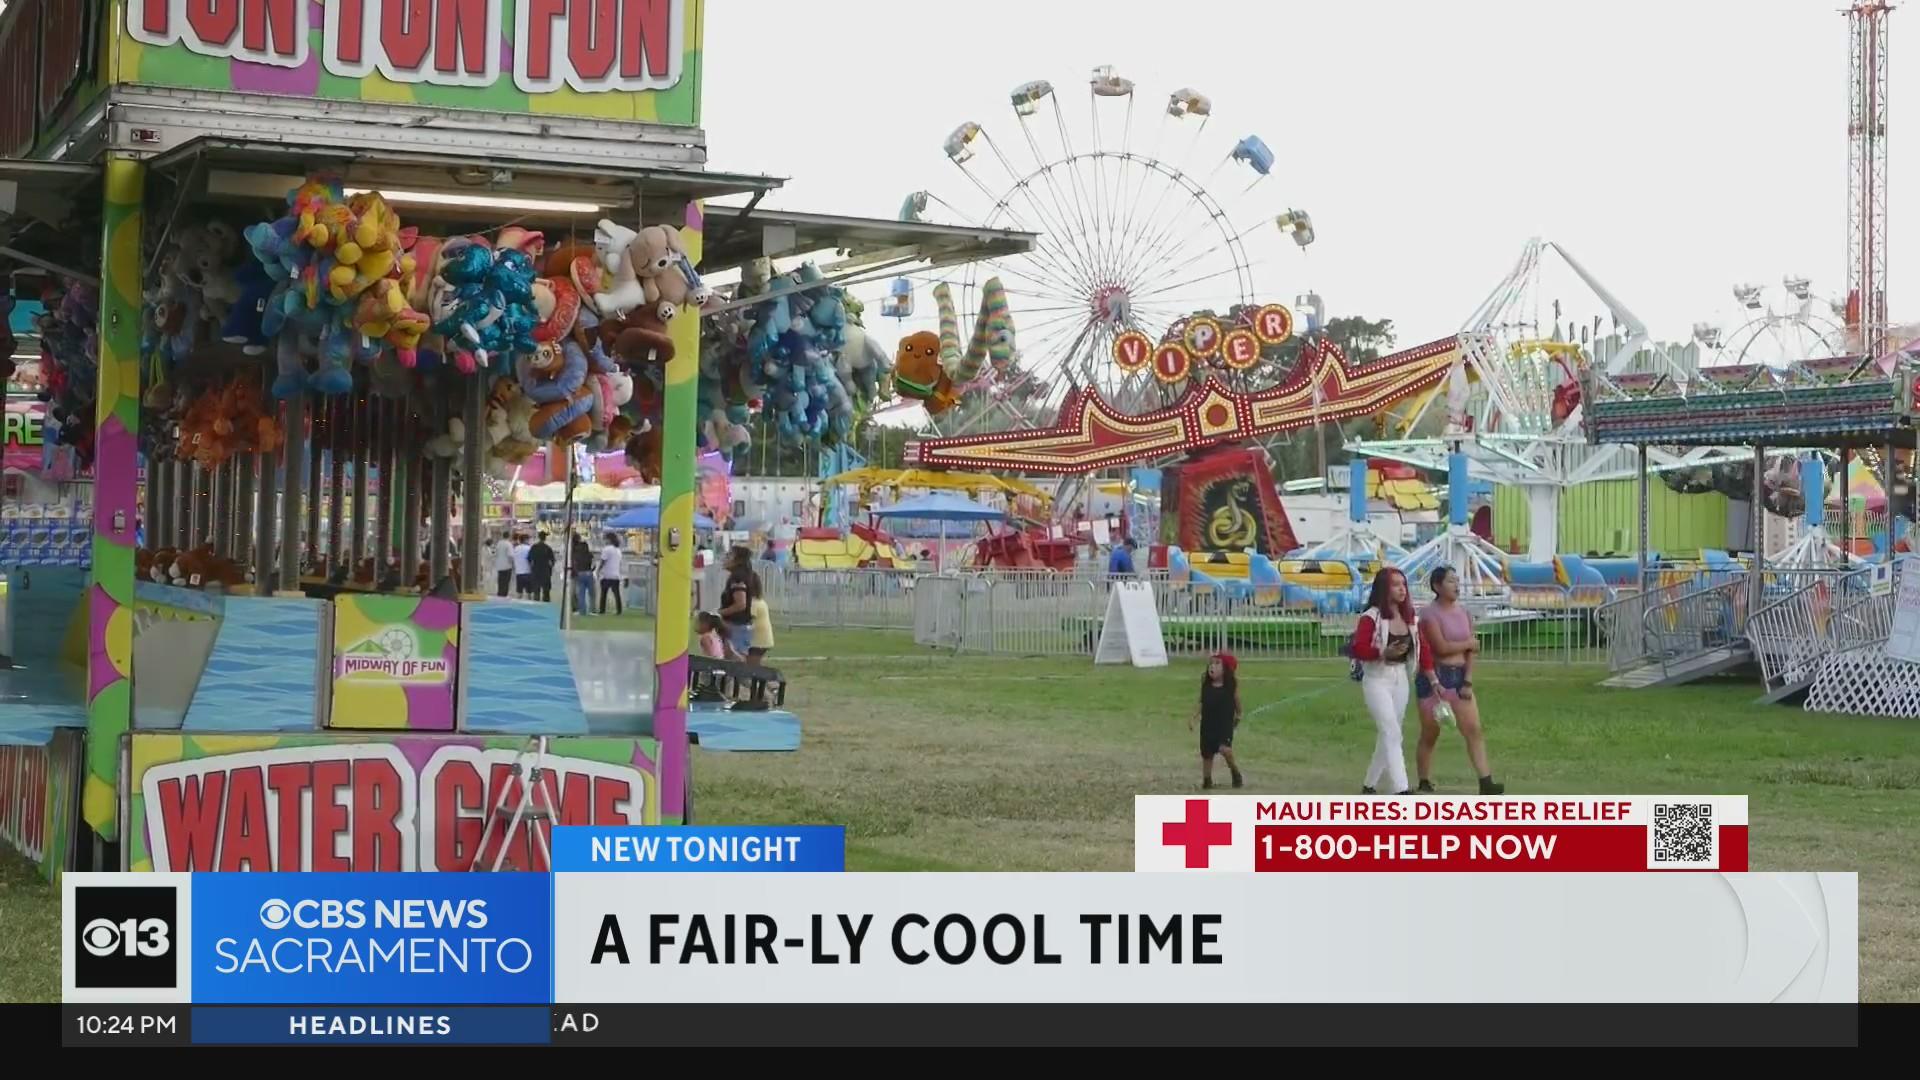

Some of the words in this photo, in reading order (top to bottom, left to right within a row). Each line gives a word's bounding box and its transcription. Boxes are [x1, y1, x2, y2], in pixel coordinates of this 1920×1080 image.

[1123, 313, 1284, 374] VIPER
[345, 660, 399, 675] MIDWAY
[402, 661, 418, 677] OF
[420, 661, 446, 673] FUN
[158, 758, 402, 872] WATER
